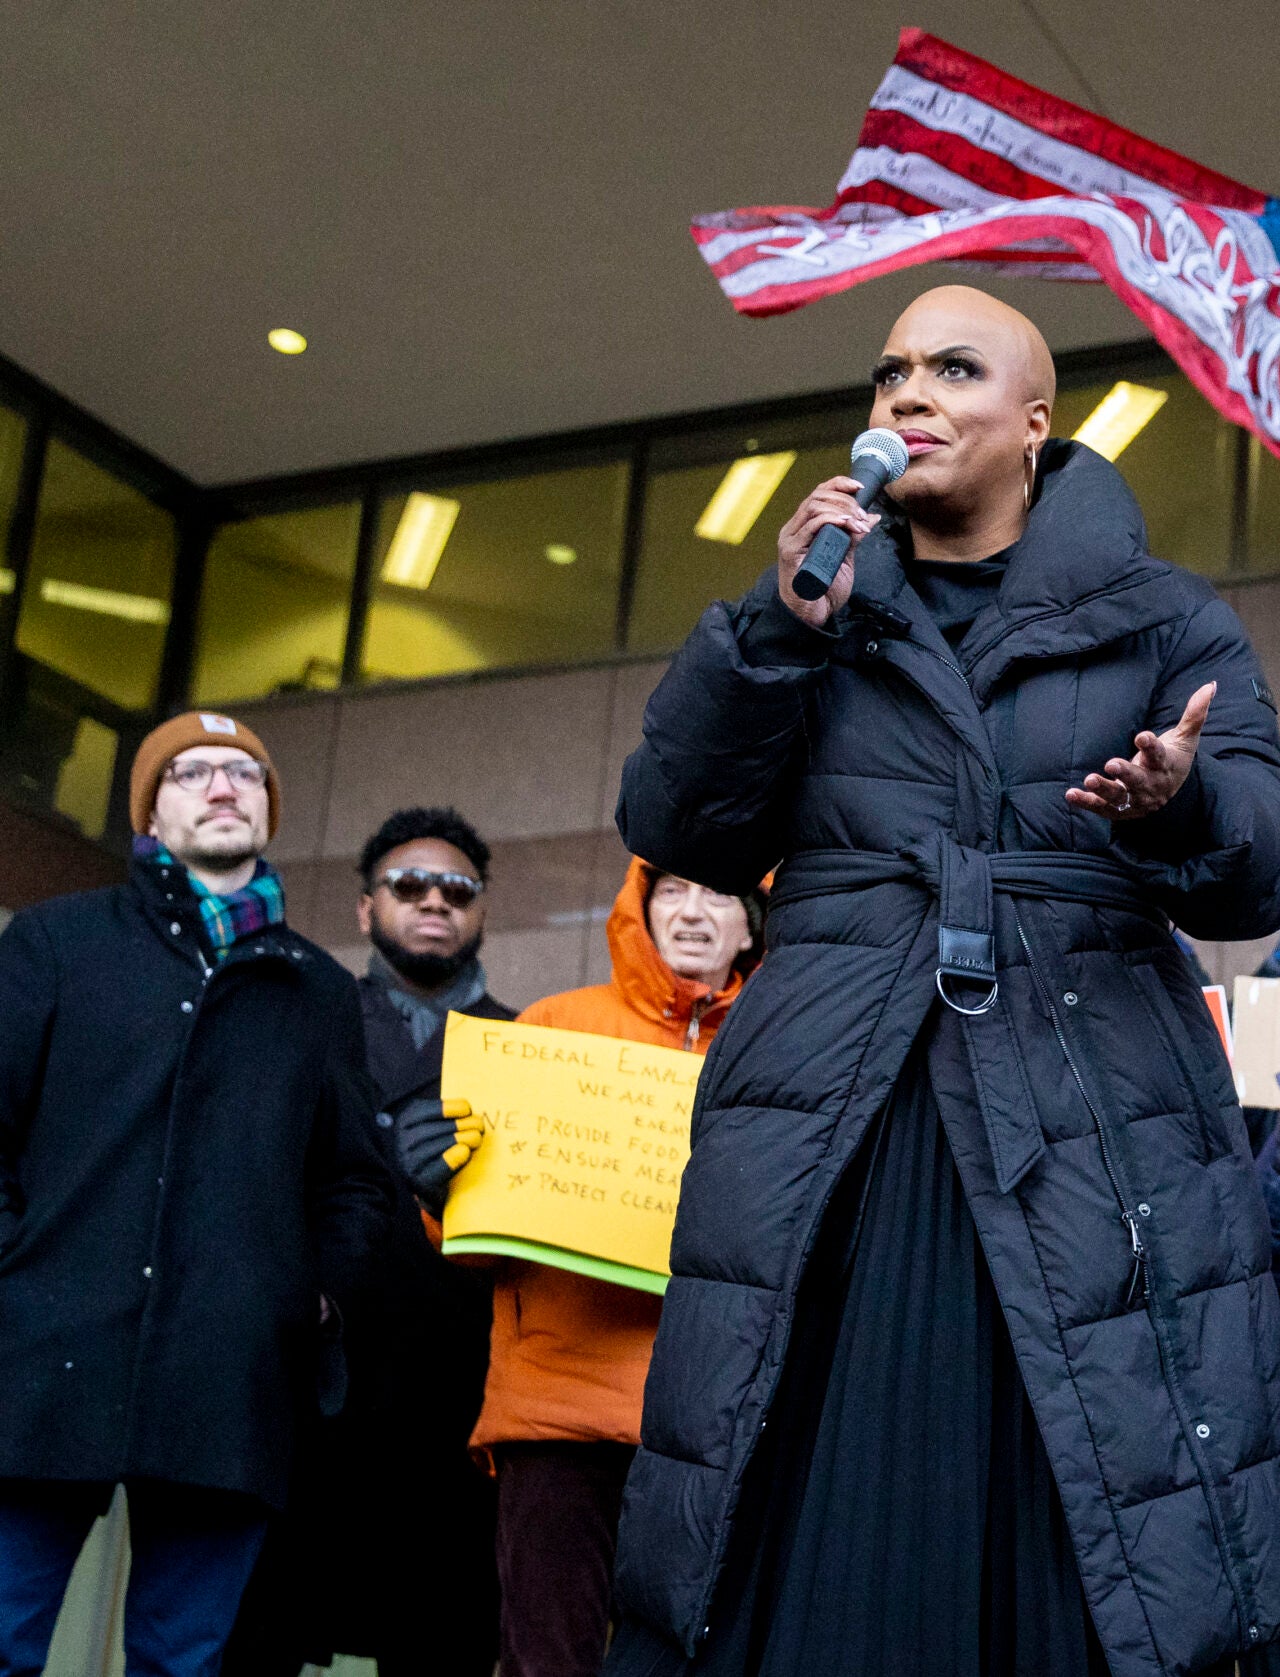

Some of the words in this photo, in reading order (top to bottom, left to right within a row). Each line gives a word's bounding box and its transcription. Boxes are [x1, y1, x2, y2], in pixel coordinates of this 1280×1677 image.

[482, 1031, 596, 1068] FEDERAL
[577, 1078, 612, 1098] WE
[618, 1089, 655, 1108] ARE
[536, 1114, 612, 1146] PROVIDE
[628, 1135, 680, 1160] FOOD
[536, 1142, 621, 1174] ENSURE
[538, 1171, 608, 1203] PROTECT
